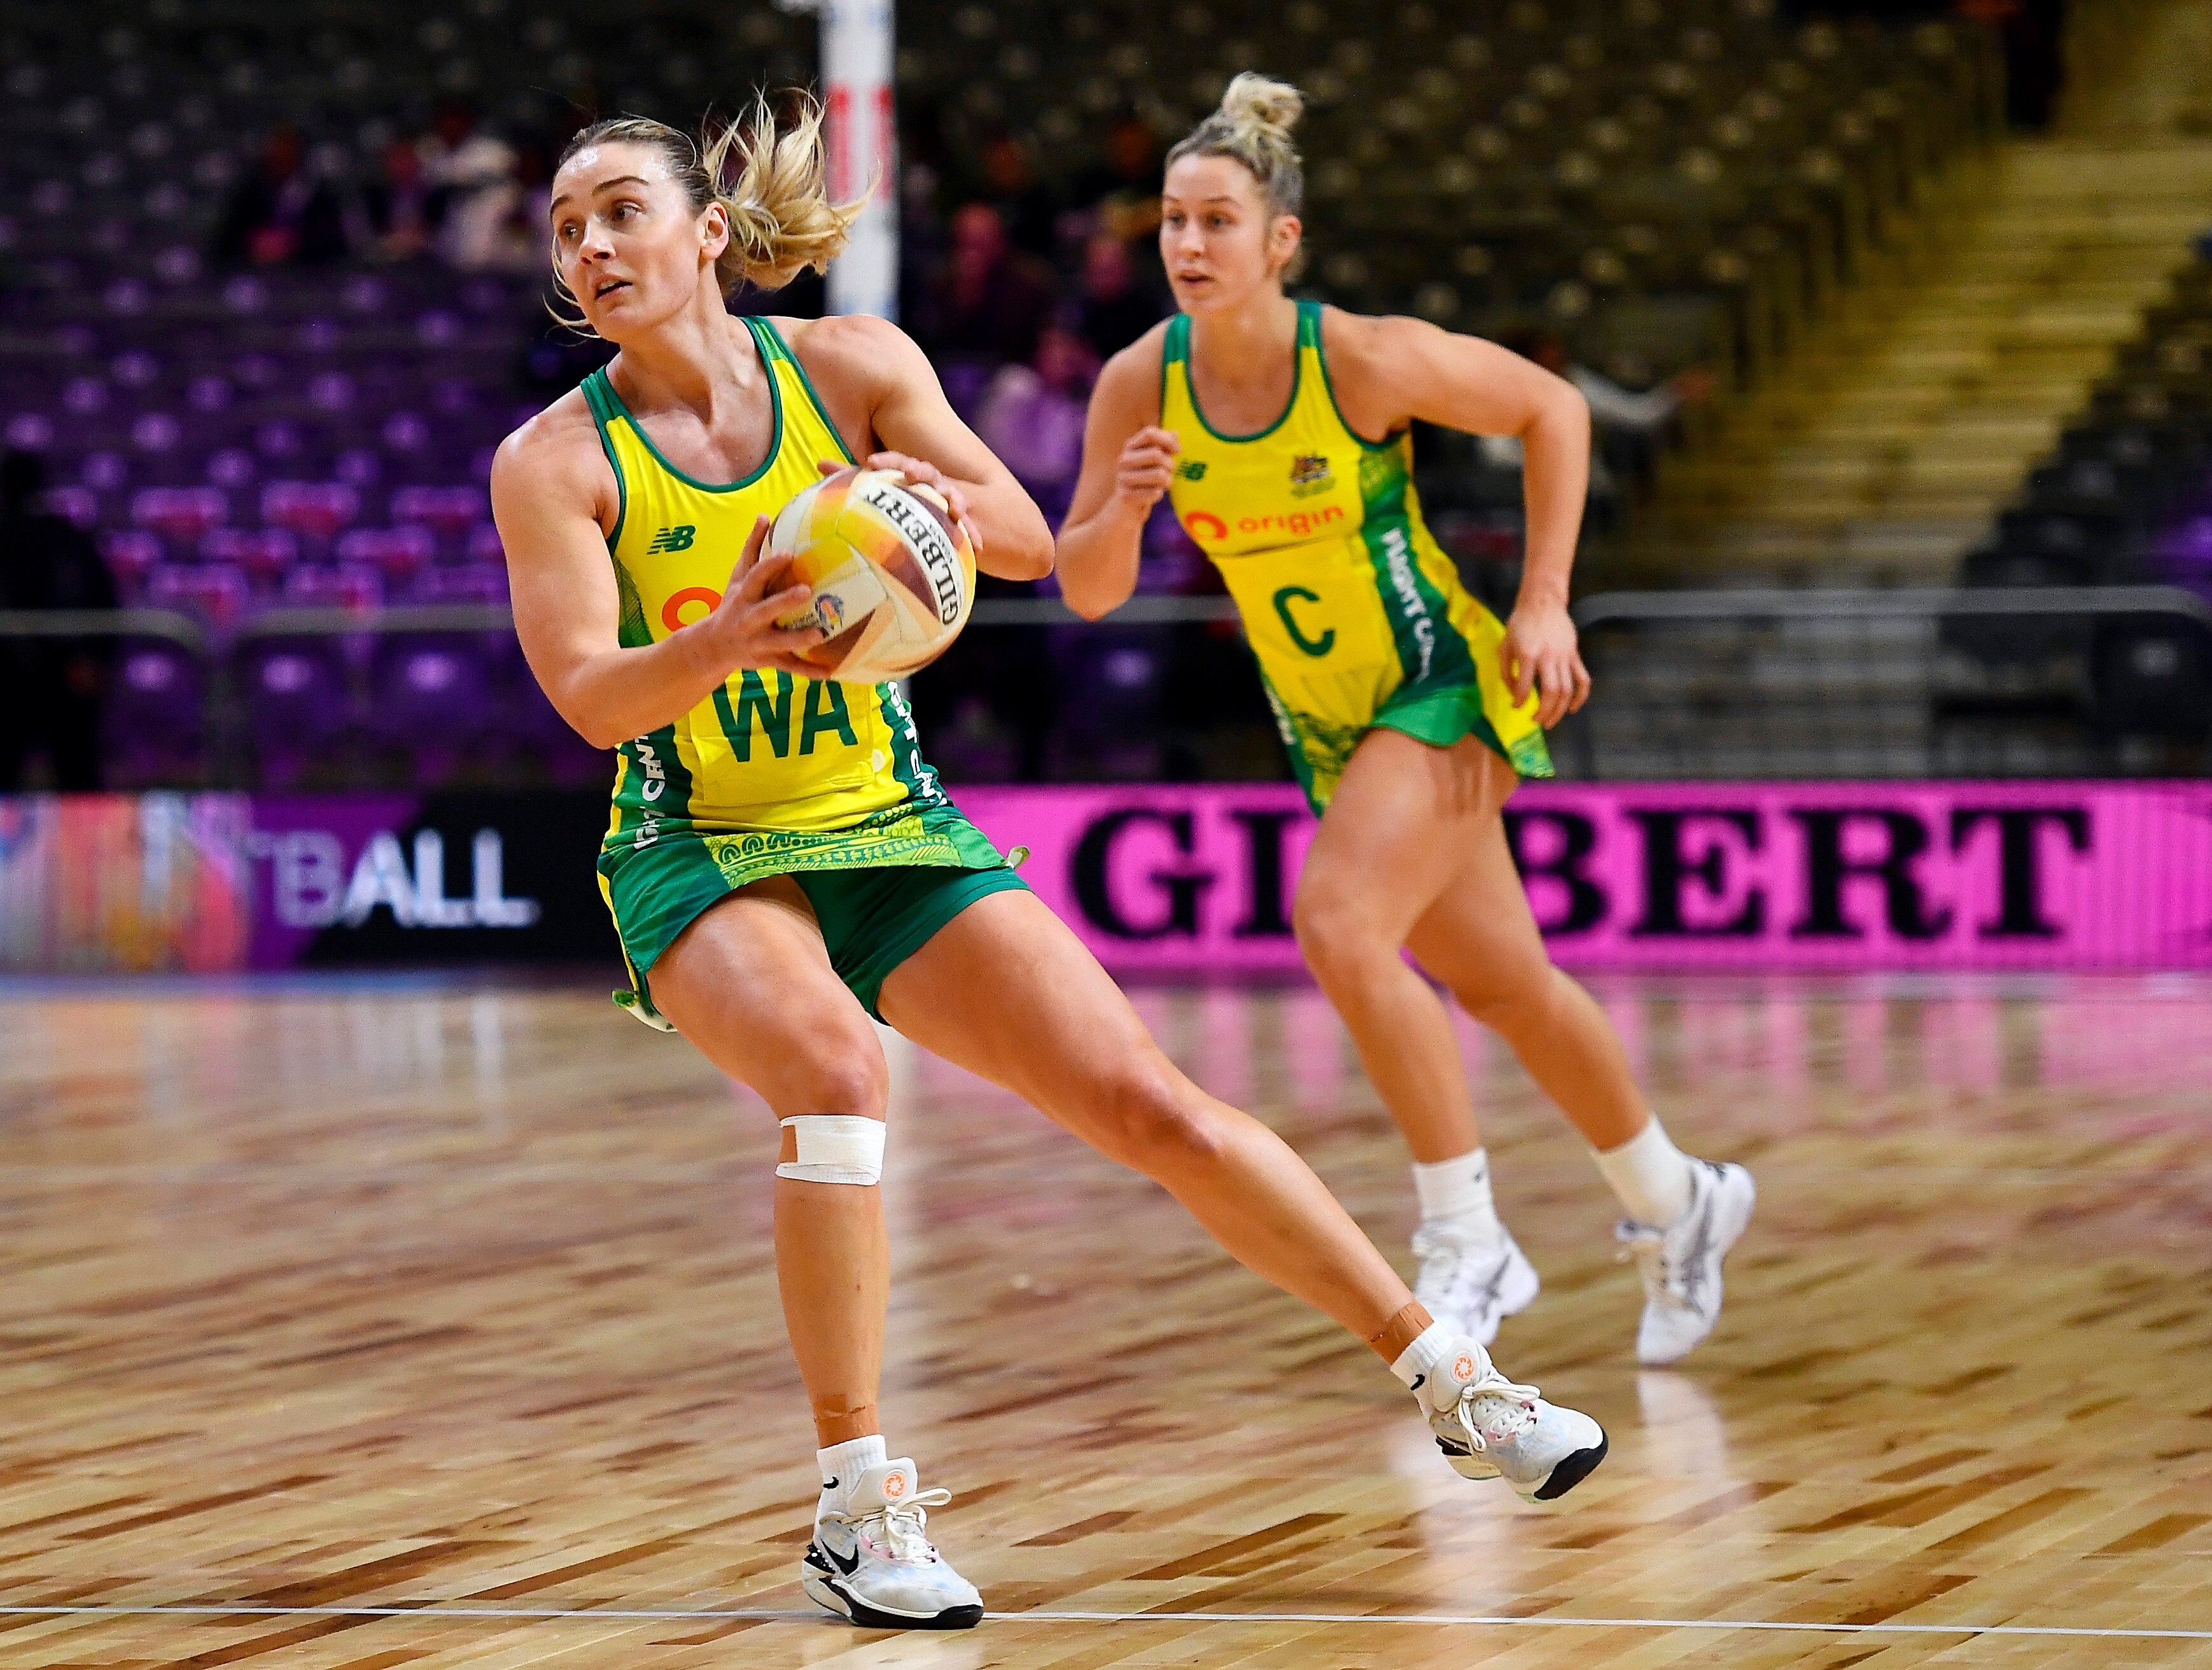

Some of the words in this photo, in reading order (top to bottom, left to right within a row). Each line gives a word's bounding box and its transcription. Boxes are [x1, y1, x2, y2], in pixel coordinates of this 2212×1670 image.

[864, 488, 959, 625] GILBERT
[1238, 505, 1345, 536] origin
[1273, 586, 1335, 657] C
[711, 668, 858, 763] WA
[1070, 808, 2090, 940] GIBERT
